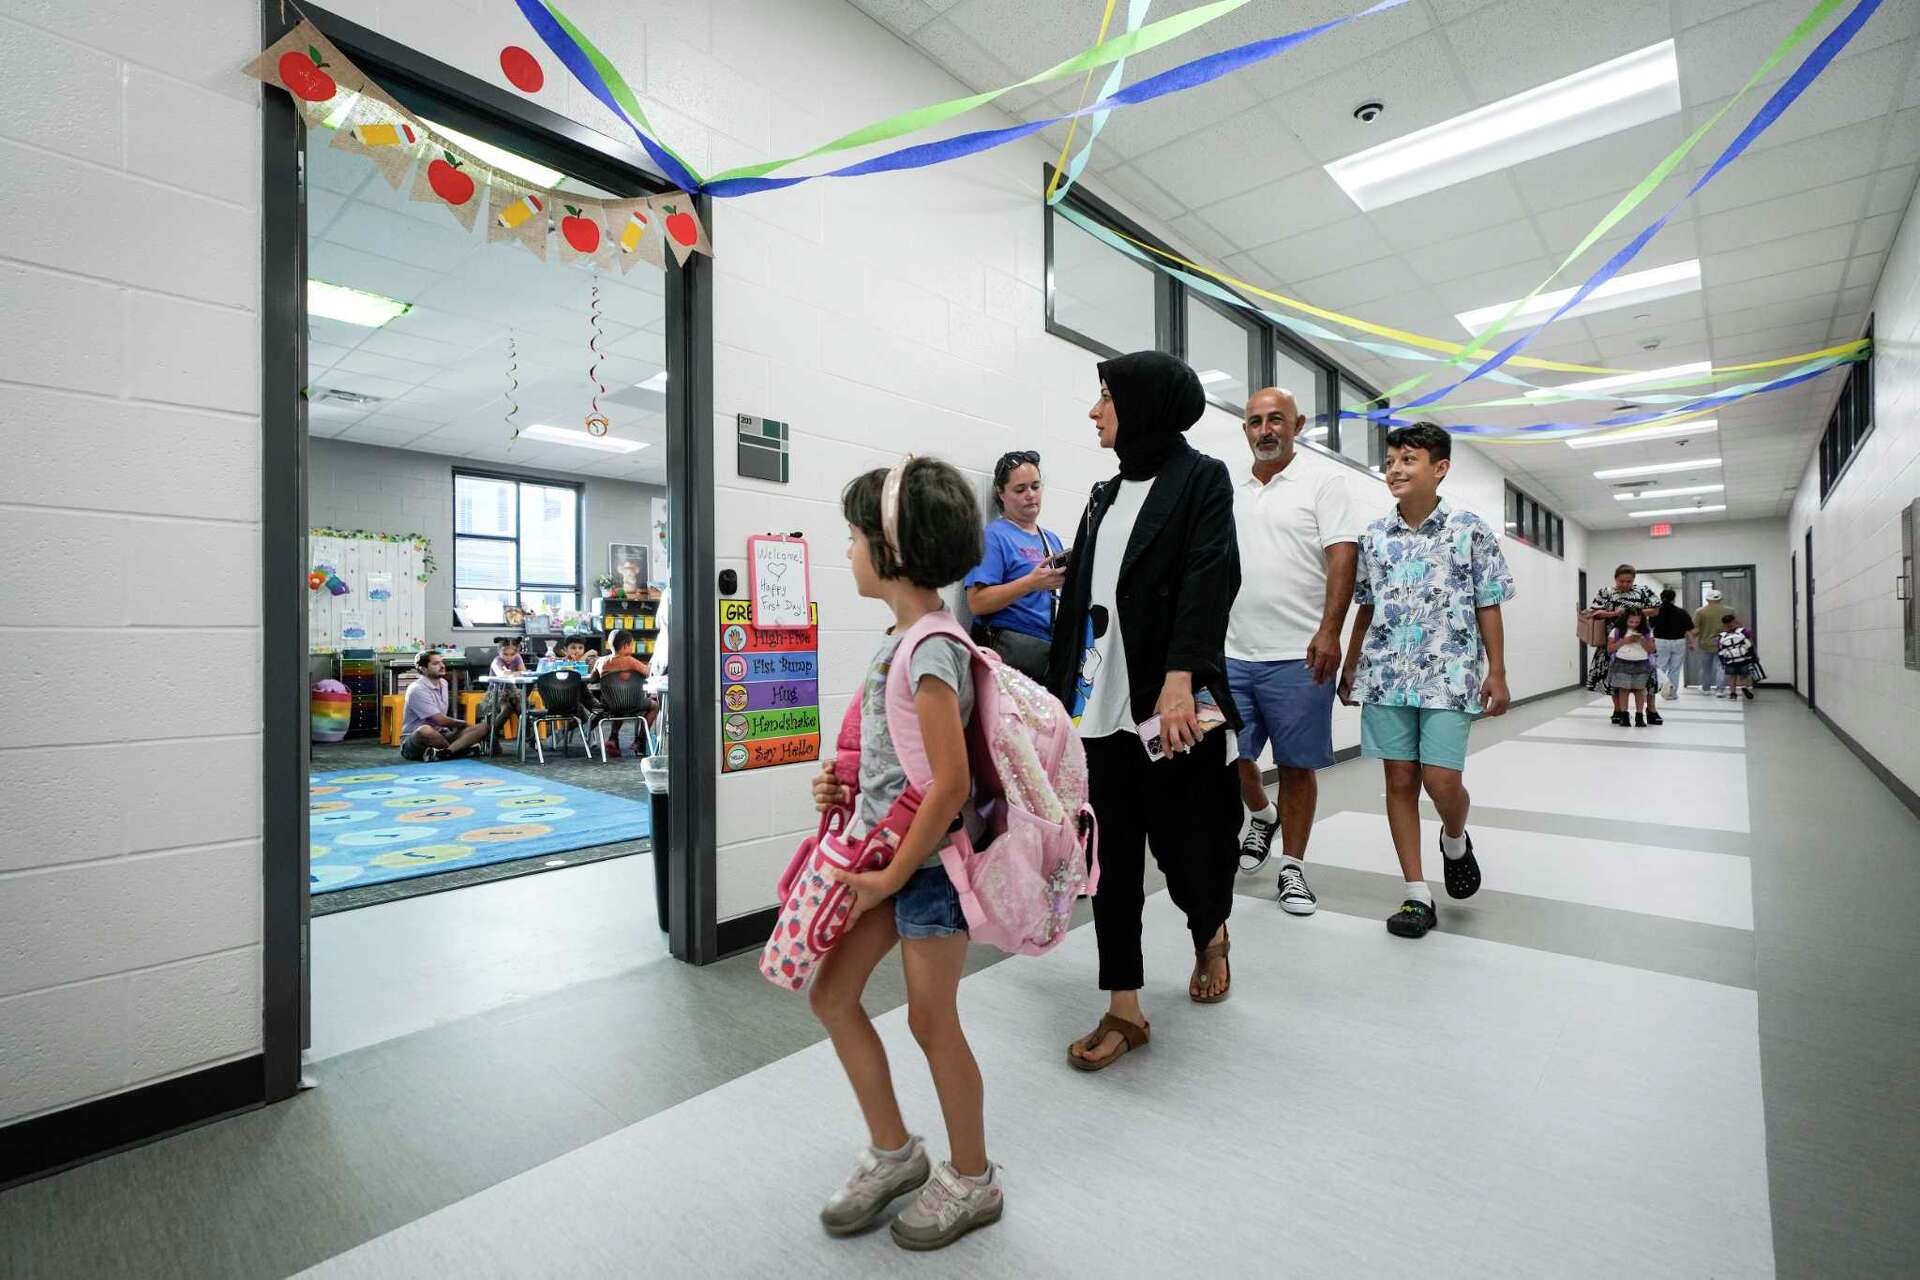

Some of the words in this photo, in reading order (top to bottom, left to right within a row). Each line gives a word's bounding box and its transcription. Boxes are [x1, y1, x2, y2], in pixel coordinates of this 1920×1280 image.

[759, 547, 803, 565] Welcome!
[760, 576, 787, 598] Happy
[784, 595, 806, 616] Day!
[752, 657, 776, 674] Fist
[779, 656, 813, 675] Bump
[771, 686, 800, 705] Hug
[752, 711, 816, 736] Handshake
[755, 745, 776, 763] Say
[780, 739, 814, 761] Hello
